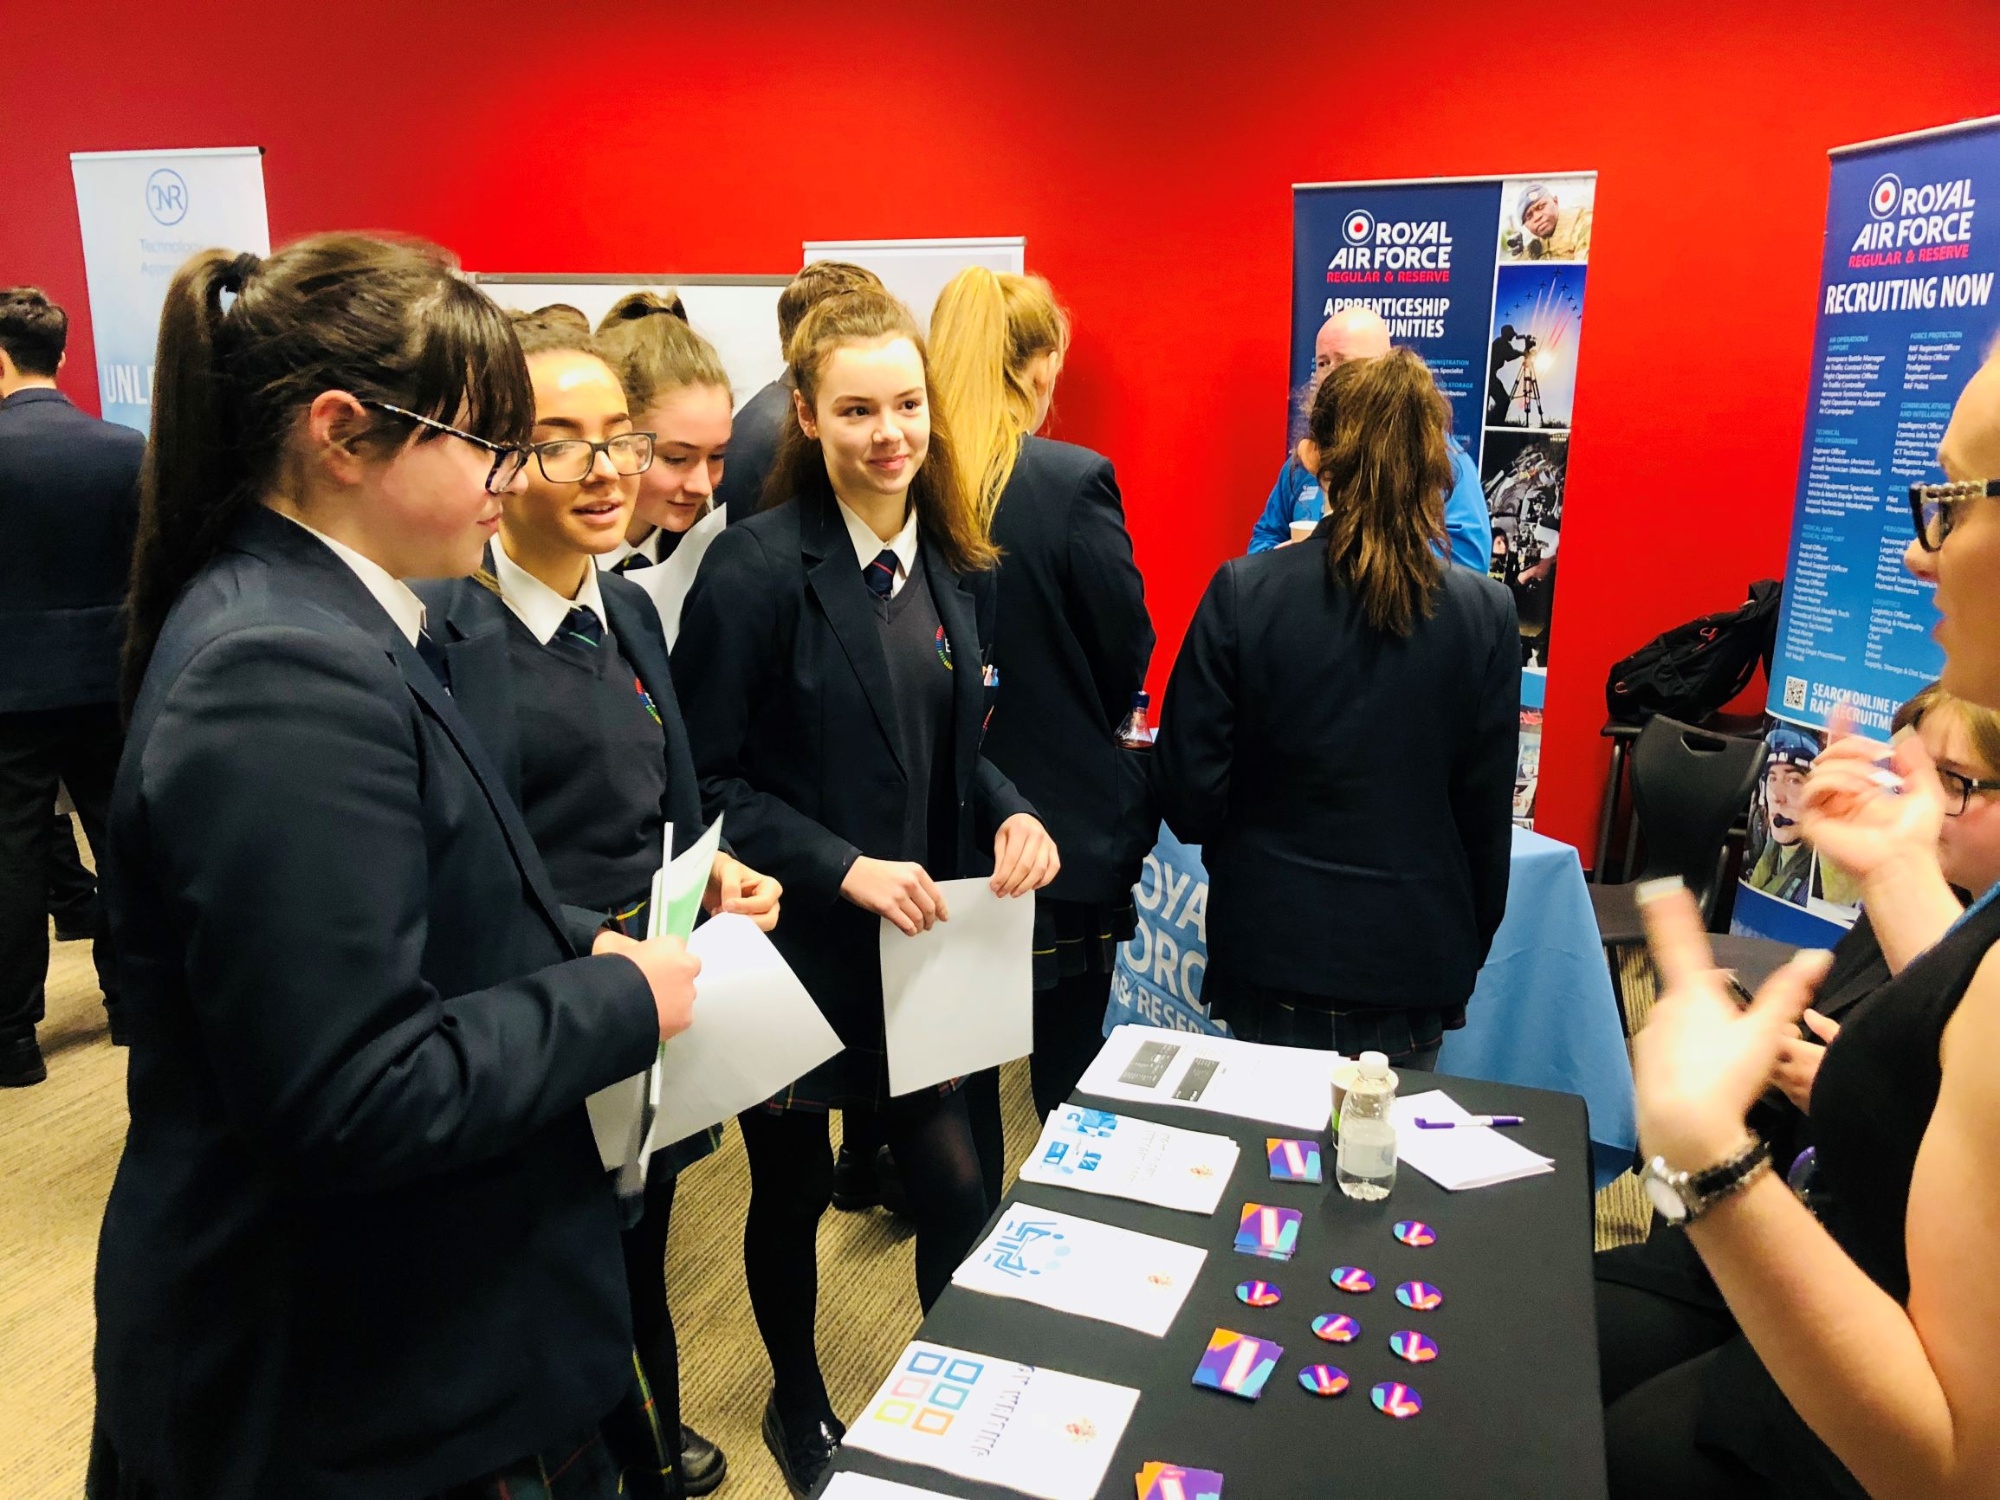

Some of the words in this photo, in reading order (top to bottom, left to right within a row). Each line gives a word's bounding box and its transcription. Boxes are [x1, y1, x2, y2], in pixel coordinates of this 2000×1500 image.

[1900, 178, 1976, 216] ROYAL
[1376, 221, 1453, 245] ROYAL
[1851, 221, 1895, 252] AIR
[1896, 210, 1975, 248] FORCE
[1328, 247, 1371, 270] AIR
[1374, 246, 1453, 269] FORCE
[1848, 249, 1902, 268] REGULAR
[1905, 248, 1916, 264] &
[1918, 244, 1970, 263] RESERVE
[1326, 270, 1381, 284] REGULAR
[1384, 271, 1394, 283] &
[1397, 270, 1450, 283] RESERVE
[1824, 276, 1938, 315] RECRUITING
[1940, 272, 1995, 310] NOW
[1386, 318, 1445, 338] UNITIES
[1811, 682, 1851, 704] SEARCH
[1852, 691, 1890, 713] ONLINE
[1133, 853, 1209, 943] OYA
[1123, 921, 1205, 1014] ORC
